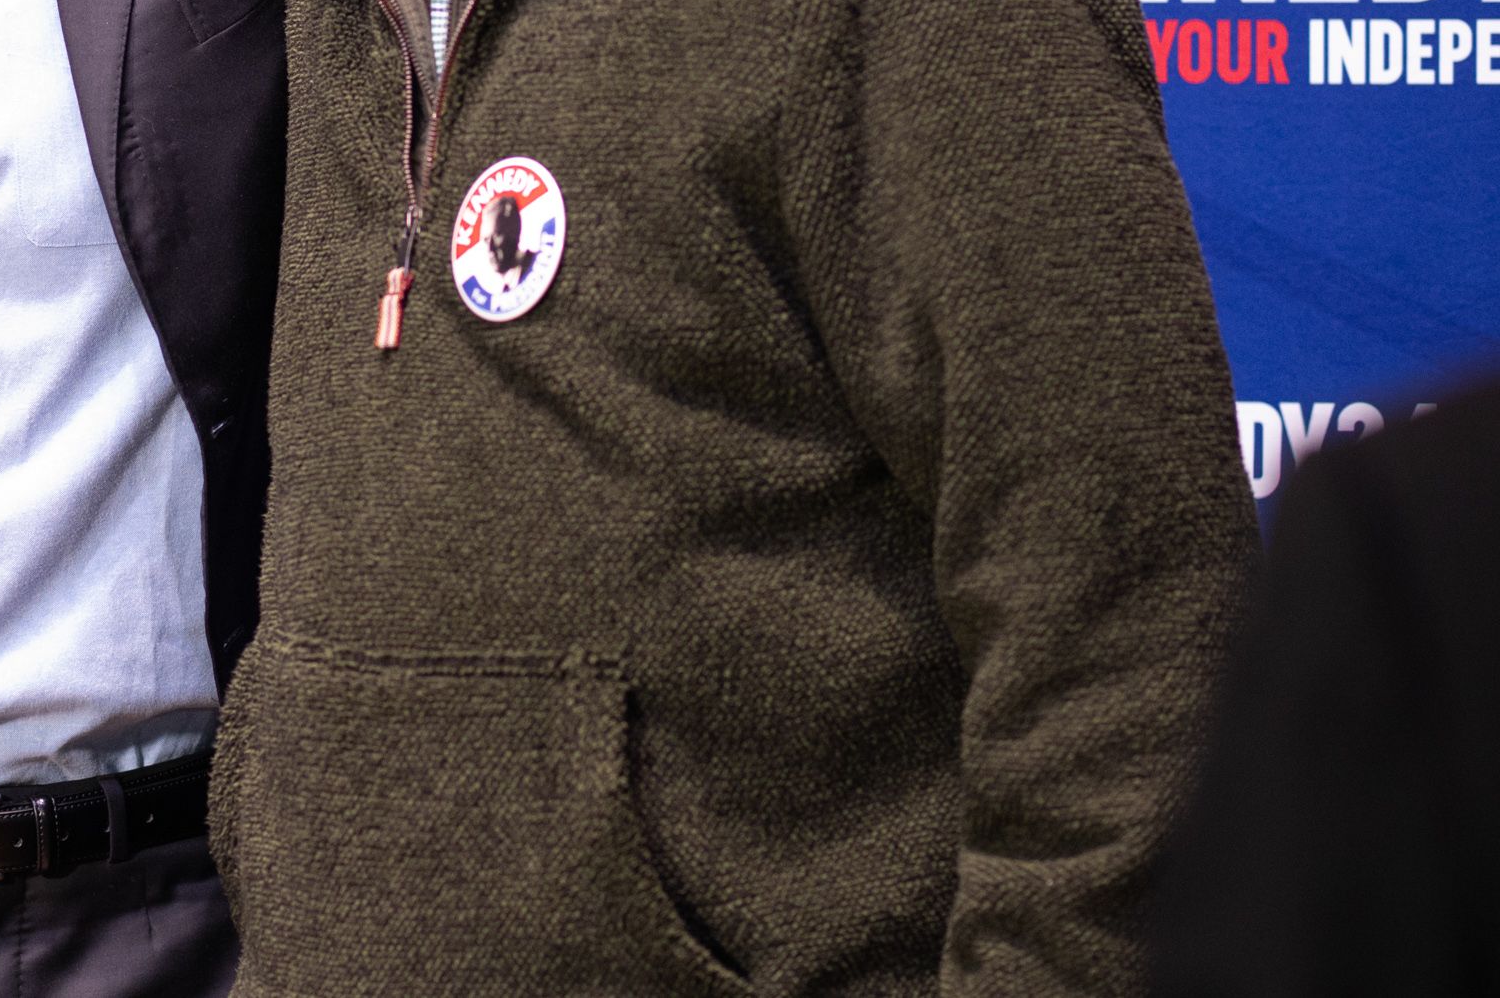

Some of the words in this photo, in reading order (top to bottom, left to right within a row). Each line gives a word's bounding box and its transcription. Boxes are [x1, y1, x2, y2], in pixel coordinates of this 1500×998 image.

[1145, 18, 1289, 84] YOUR
[1309, 18, 1500, 85] INDEPE
[456, 168, 540, 246] KENNEDY
